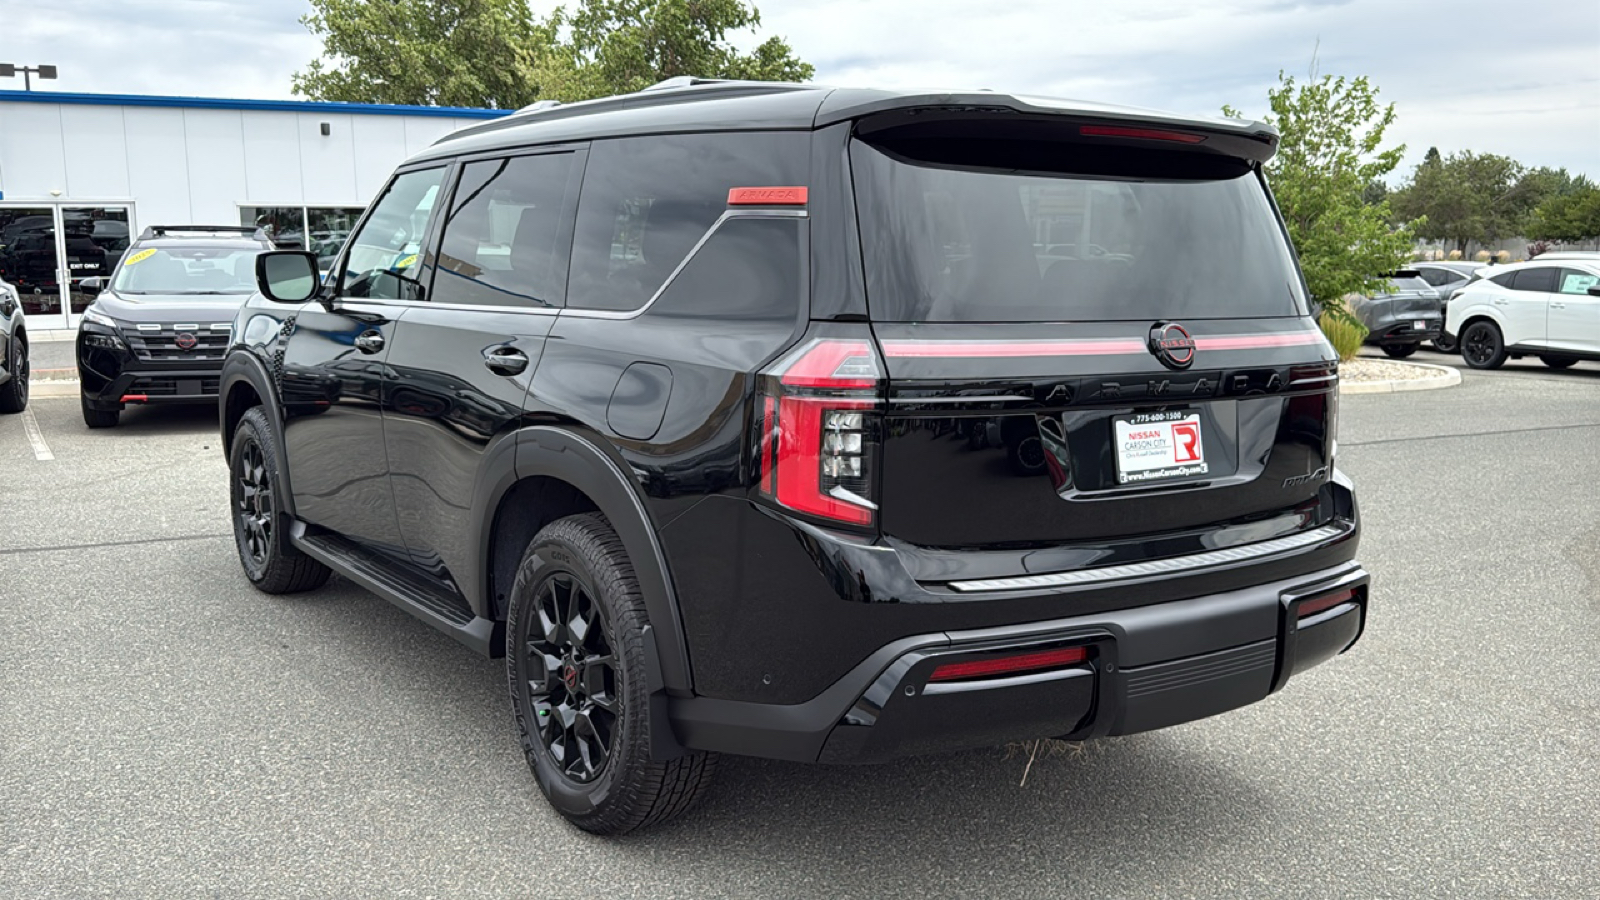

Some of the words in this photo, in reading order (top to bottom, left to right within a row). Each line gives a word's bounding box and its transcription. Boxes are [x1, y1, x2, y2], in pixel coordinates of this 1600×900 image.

[1129, 430, 1161, 440] NISSAN
[1124, 440, 1152, 450] CARSON
[1153, 439, 1167, 448] CITY
